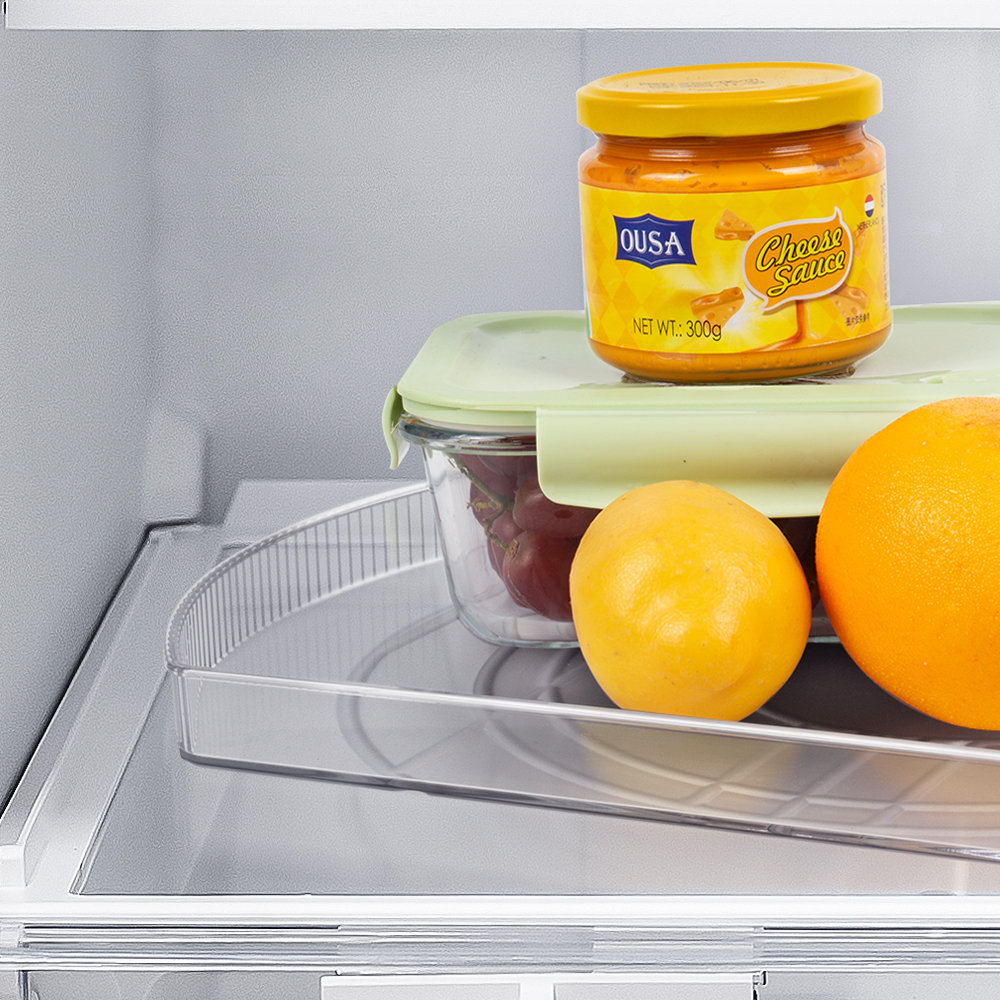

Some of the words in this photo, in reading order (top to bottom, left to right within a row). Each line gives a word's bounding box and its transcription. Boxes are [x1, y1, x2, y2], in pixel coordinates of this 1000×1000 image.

[620, 228, 685, 255] OUSA
[755, 227, 842, 272] Cheese
[767, 250, 845, 297] Sauce
[633, 318, 653, 335] NET
[686, 320, 721, 341] 300g
